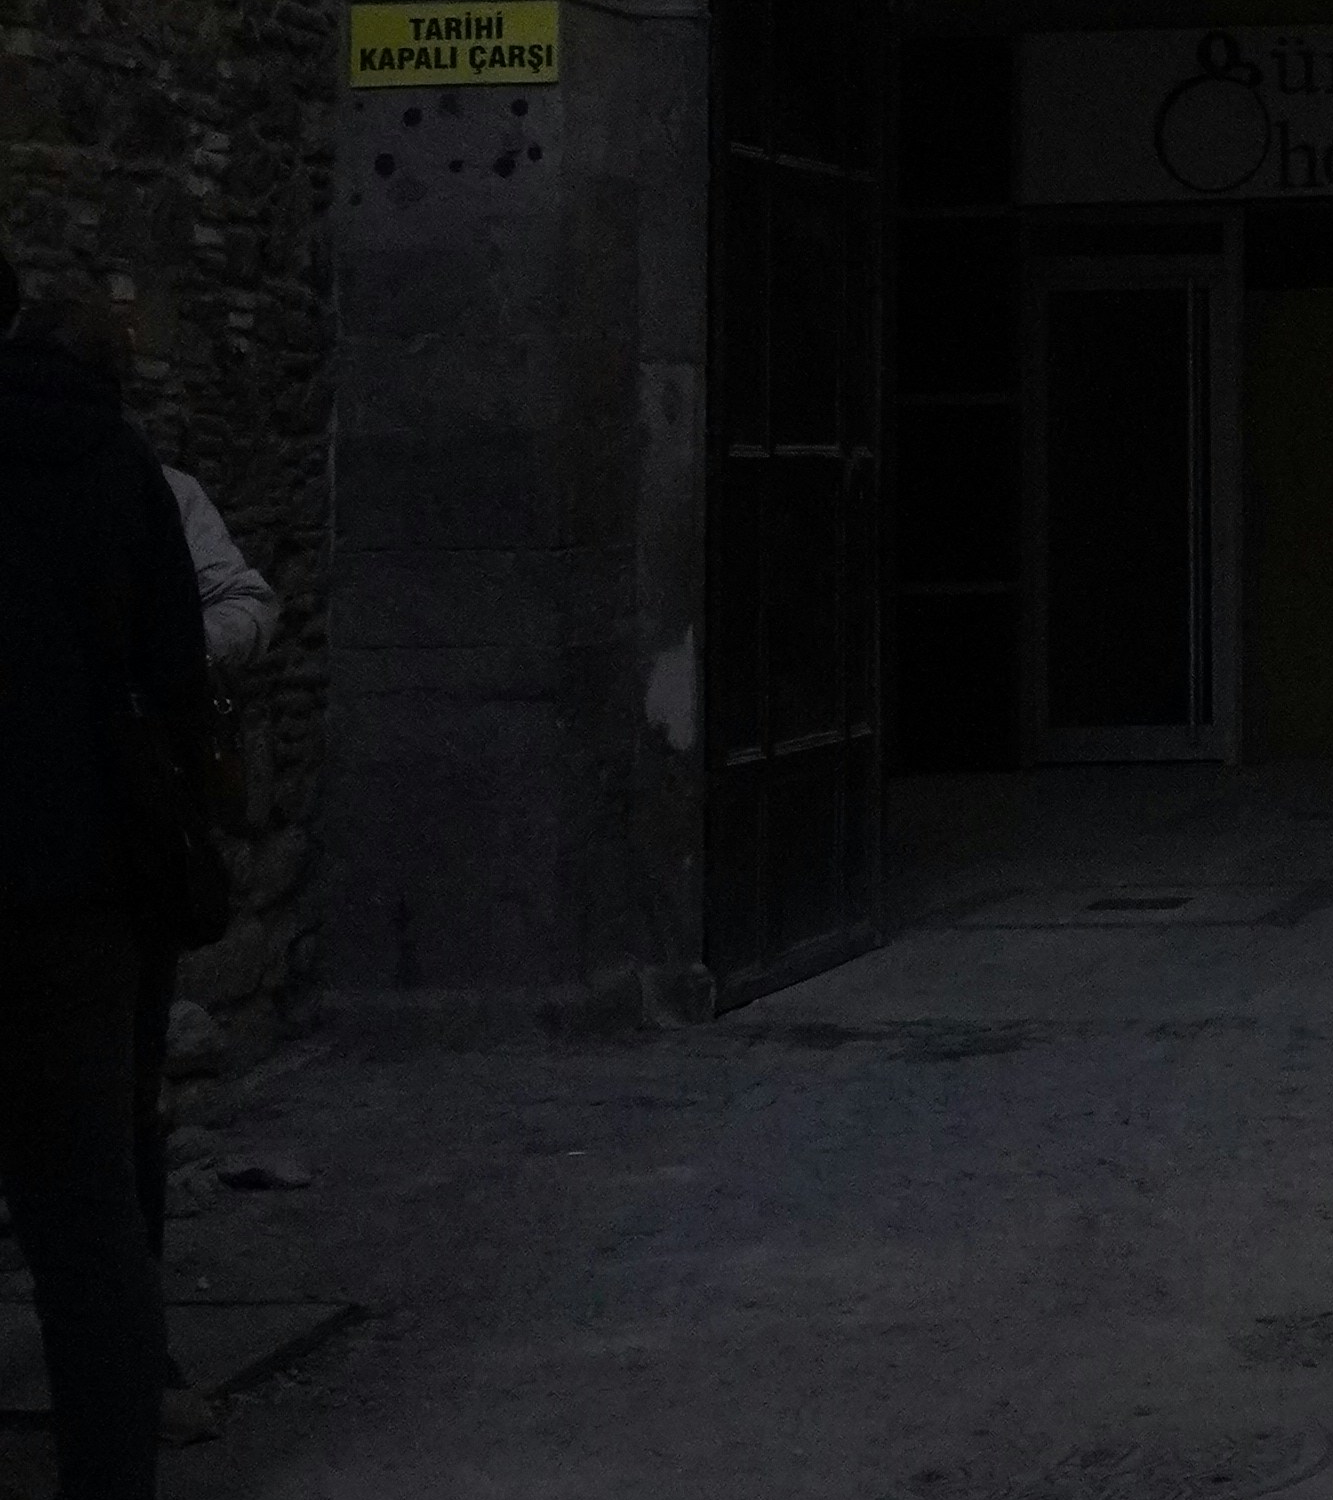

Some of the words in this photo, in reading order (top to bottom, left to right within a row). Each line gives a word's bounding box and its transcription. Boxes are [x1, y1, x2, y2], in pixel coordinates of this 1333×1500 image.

[409, 11, 504, 42] TARİHİ
[358, 46, 457, 73] KAPALI
[467, 42, 553, 76] ÇARŞI
